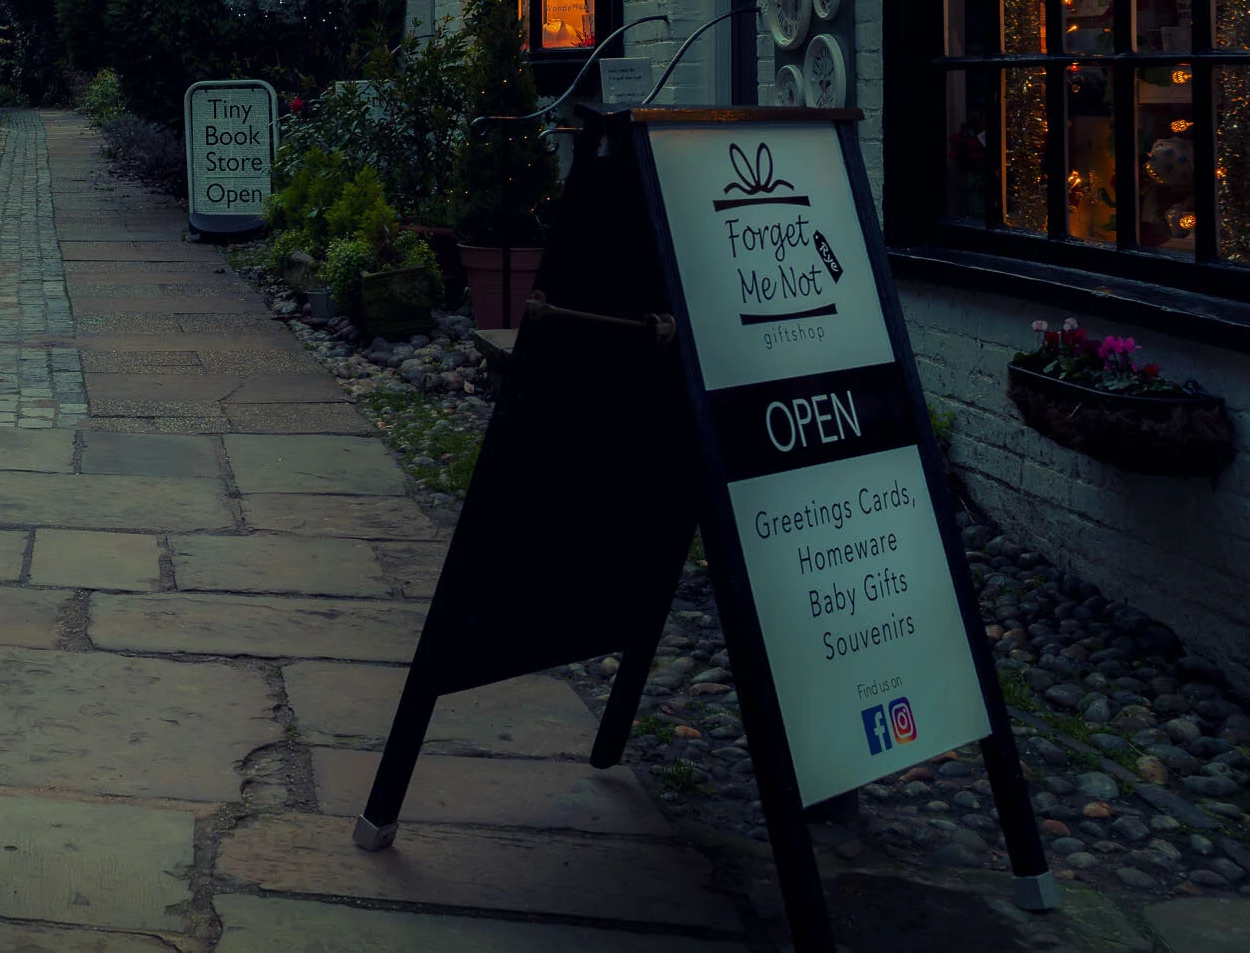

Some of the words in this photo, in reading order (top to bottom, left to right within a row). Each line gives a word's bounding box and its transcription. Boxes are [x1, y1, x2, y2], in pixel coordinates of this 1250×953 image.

[207, 99, 252, 124] Tiny
[206, 125, 261, 146] Book
[206, 152, 263, 172] Store
[206, 183, 262, 208] Open
[725, 214, 810, 261] Forget
[818, 240, 840, 273] Rye
[737, 268, 777, 303] Me
[778, 264, 823, 299] Not
[764, 324, 825, 350] giftshop
[765, 390, 863, 453] OPEN
[755, 498, 853, 539] Greetings
[858, 480, 916, 514] Cards,
[798, 532, 898, 575] Homeware
[808, 582, 856, 617] Baby
[863, 568, 908, 601] Gifts
[822, 612, 915, 660] Souvenirs
[857, 678, 878, 699] Find
[879, 678, 890, 693] us
[890, 675, 903, 690] on
